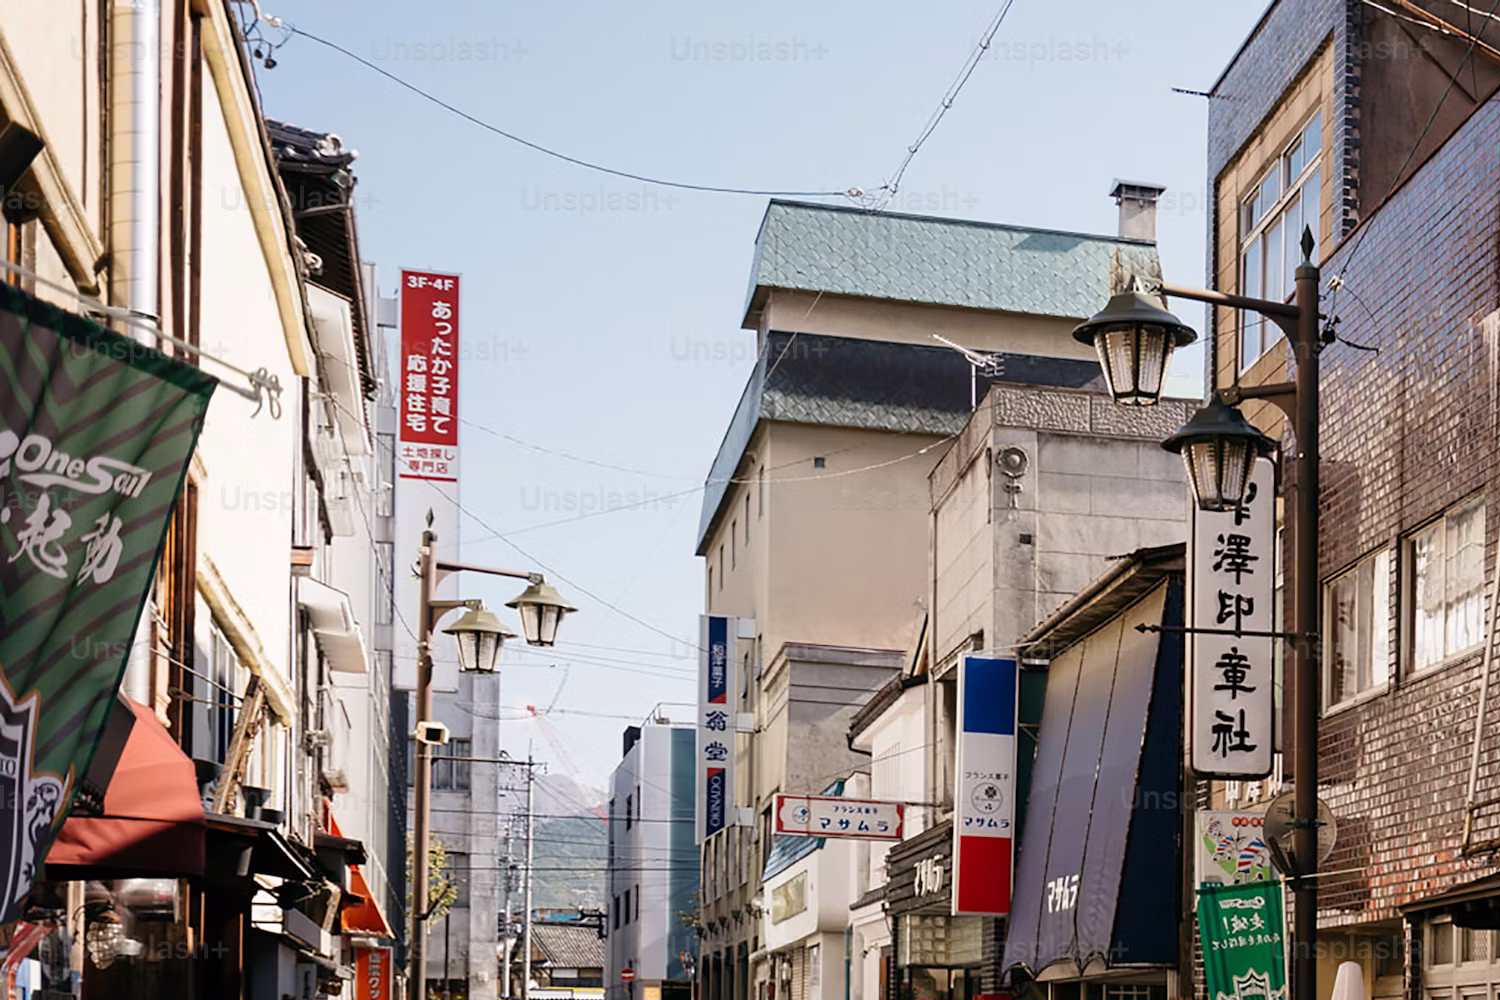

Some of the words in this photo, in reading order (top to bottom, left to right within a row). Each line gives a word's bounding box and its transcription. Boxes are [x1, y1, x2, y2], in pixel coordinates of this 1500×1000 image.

[406, 354, 427, 433] 応援住宅
[431, 301, 452, 434] あったか子育て
[704, 710, 729, 762] 翁堂
[709, 775, 721, 828] OKINADO
[819, 816, 889, 832] マサムラ
[963, 816, 1010, 829] マサムラ
[1047, 873, 1080, 913] マサムラ
